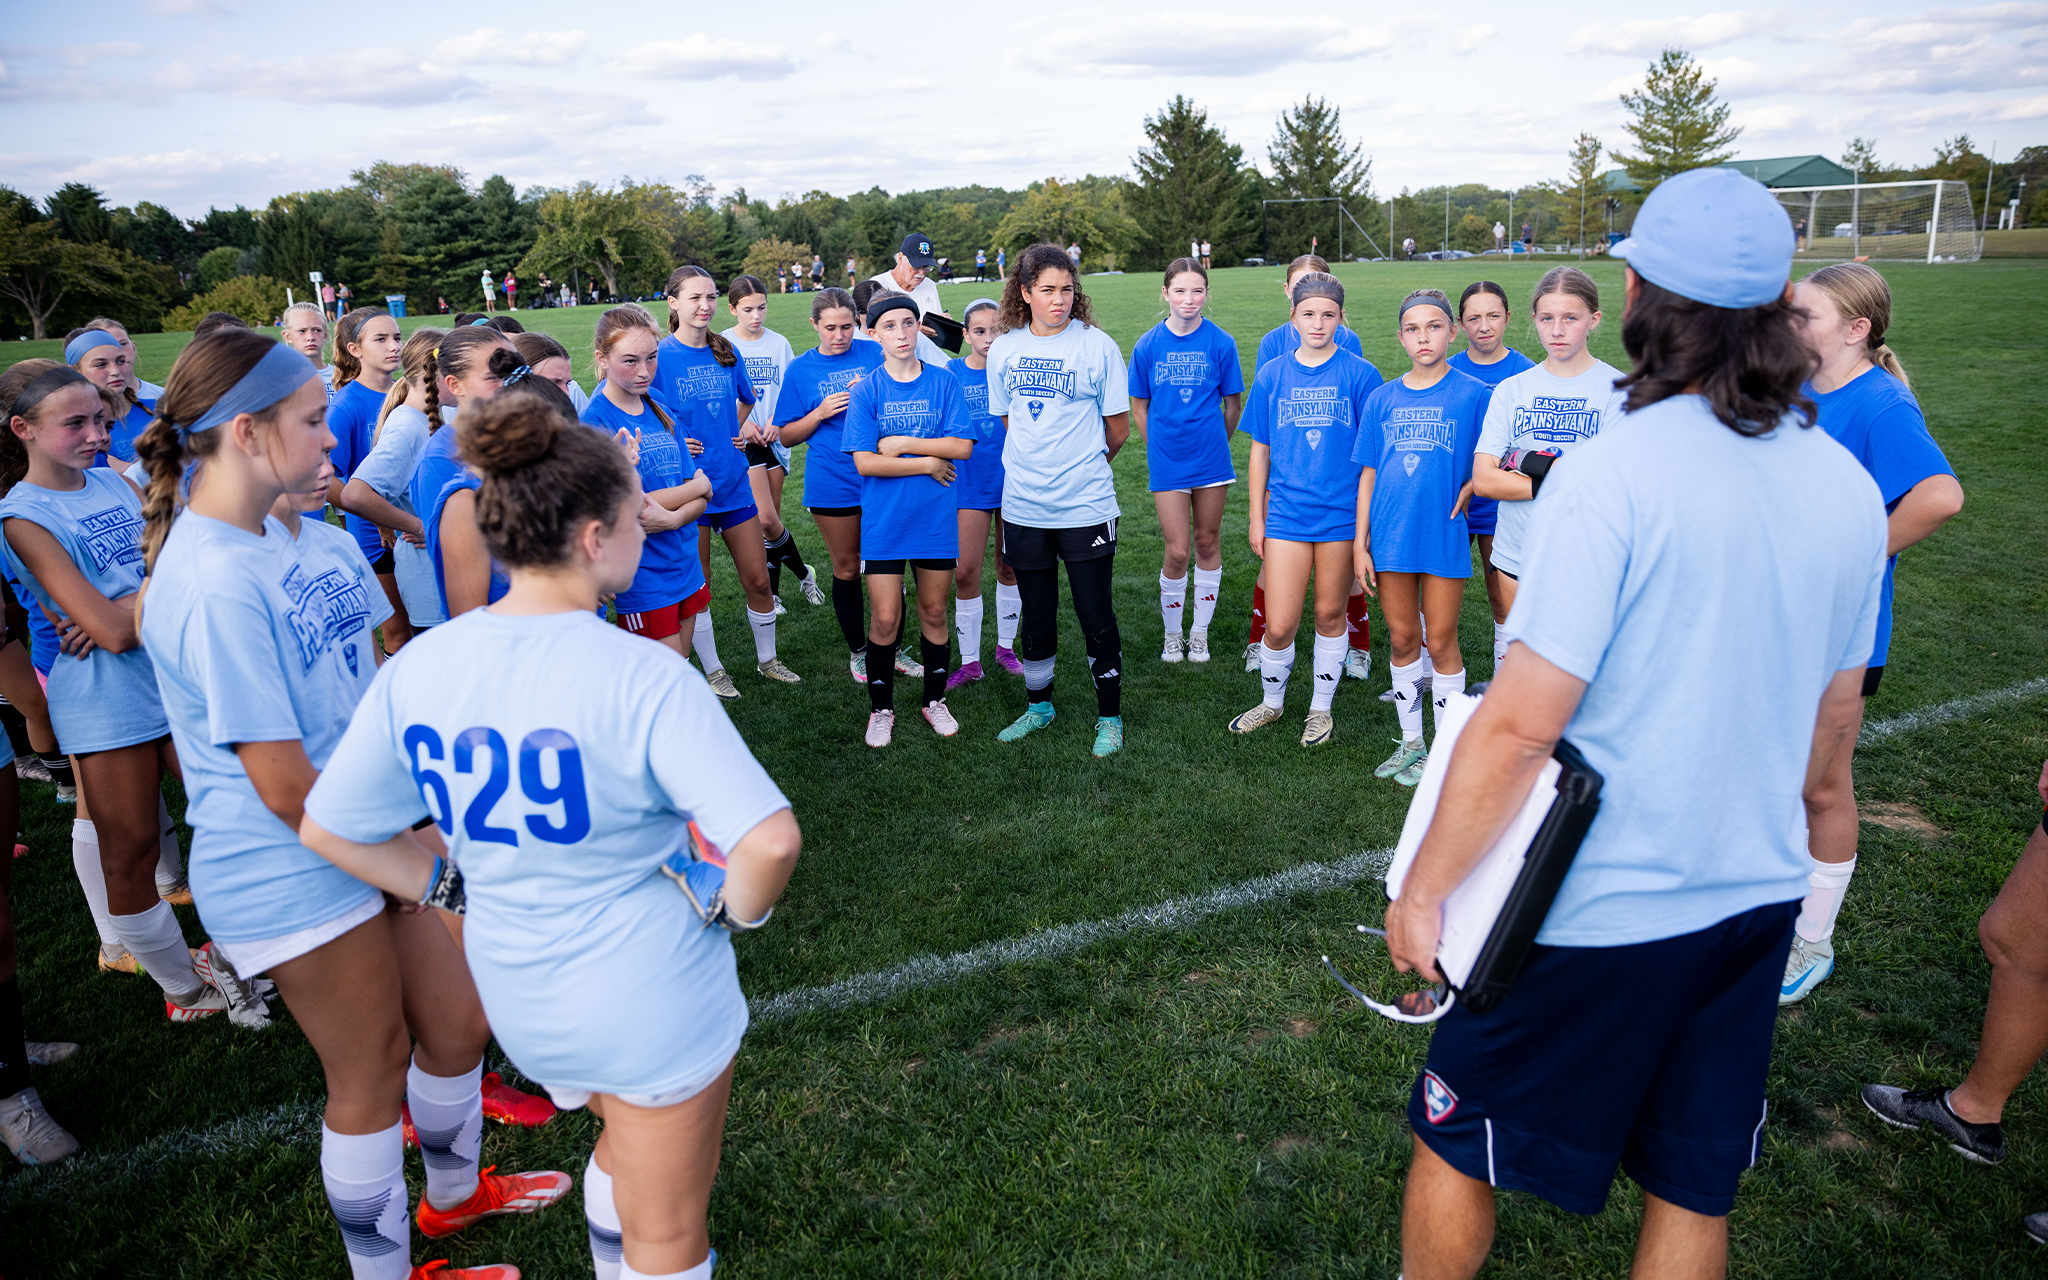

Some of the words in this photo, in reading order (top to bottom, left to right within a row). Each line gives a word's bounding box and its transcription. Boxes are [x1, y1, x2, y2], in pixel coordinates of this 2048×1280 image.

[1169, 353, 1204, 362] EASTERN
[1020, 358, 1062, 370] EASTERN
[830, 368, 866, 381] EASTERN
[1008, 367, 1075, 398] PENNSYLVANIA
[965, 386, 989, 396] EASTE
[1293, 388, 1335, 399] EASTERN
[886, 402, 927, 414] EASTERN
[1534, 398, 1586, 411] EASTERN
[1280, 399, 1350, 425] PENNSYLVANIA
[1395, 409, 1440, 421] EASTERN
[1514, 407, 1599, 438] PENNSYLVANIA
[1552, 433, 1575, 442] SOCCER
[404, 724, 591, 848] 629
